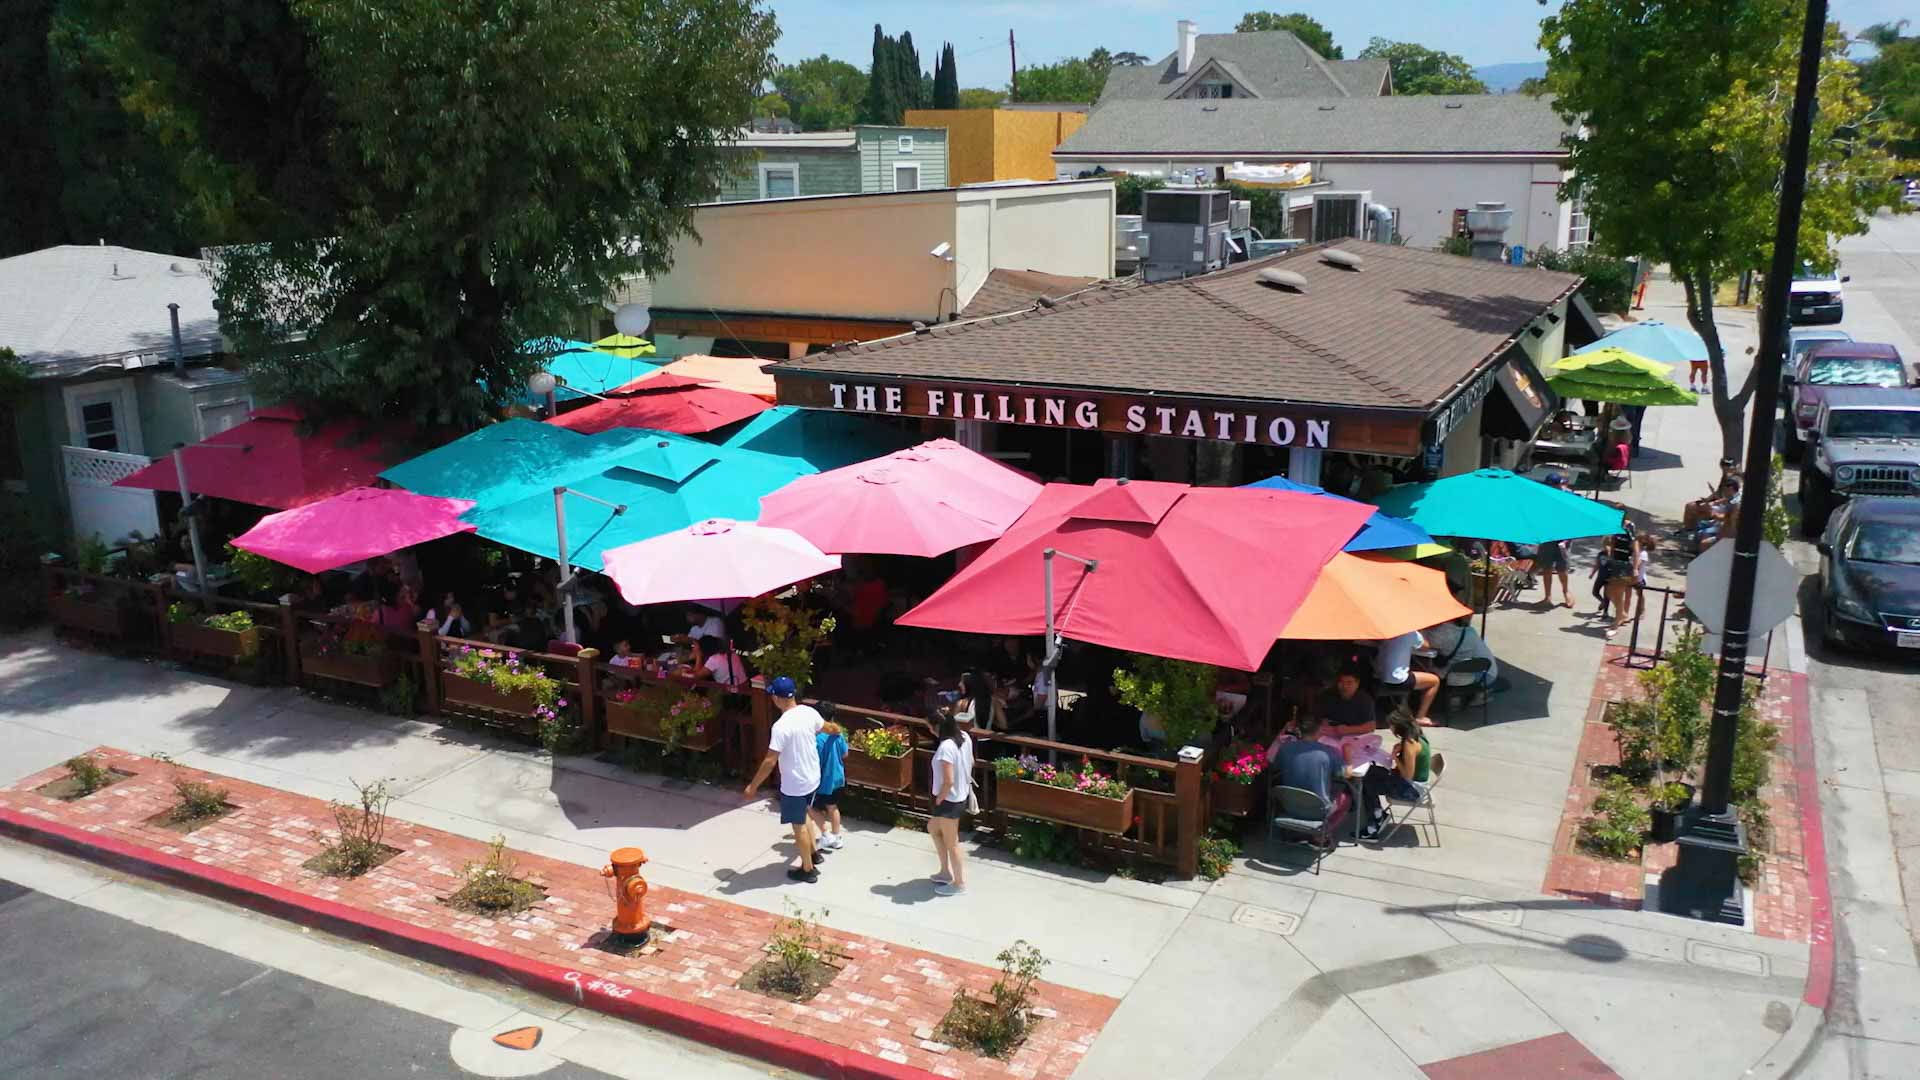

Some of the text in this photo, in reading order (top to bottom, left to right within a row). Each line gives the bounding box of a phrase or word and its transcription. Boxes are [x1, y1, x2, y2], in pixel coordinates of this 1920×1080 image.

[829, 383, 1331, 448] THE FILLING STATION
